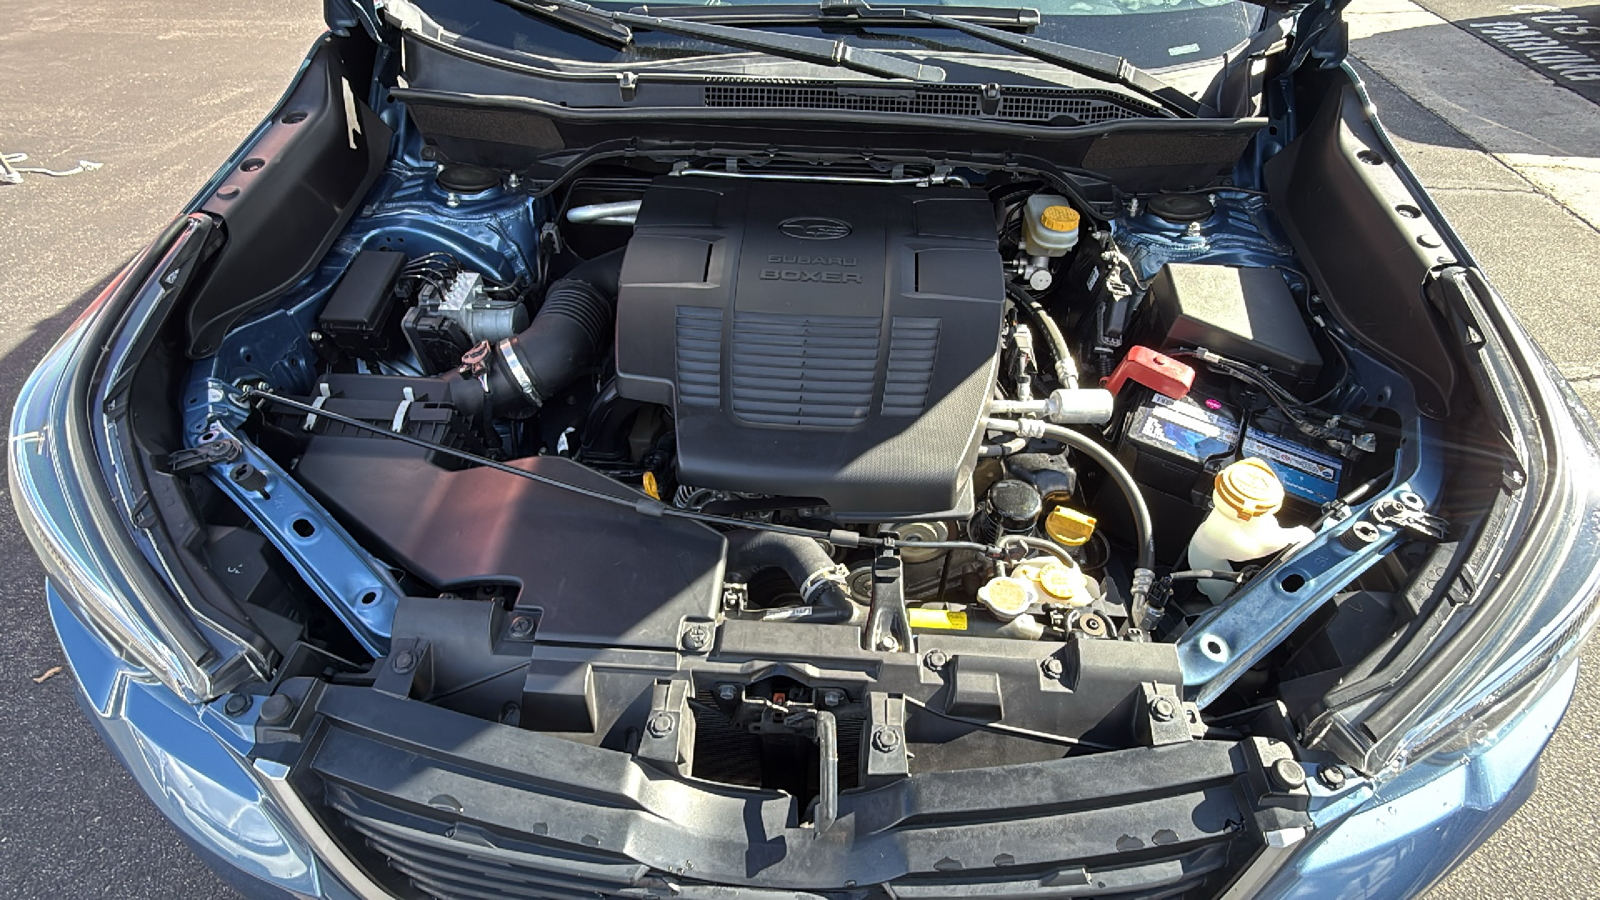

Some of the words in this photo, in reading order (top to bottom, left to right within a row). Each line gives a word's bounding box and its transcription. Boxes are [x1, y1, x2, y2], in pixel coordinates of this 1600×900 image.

[1469, 21, 1600, 81] PARKING
[767, 254, 858, 266] SUBARU
[759, 268, 863, 284] BOXER
